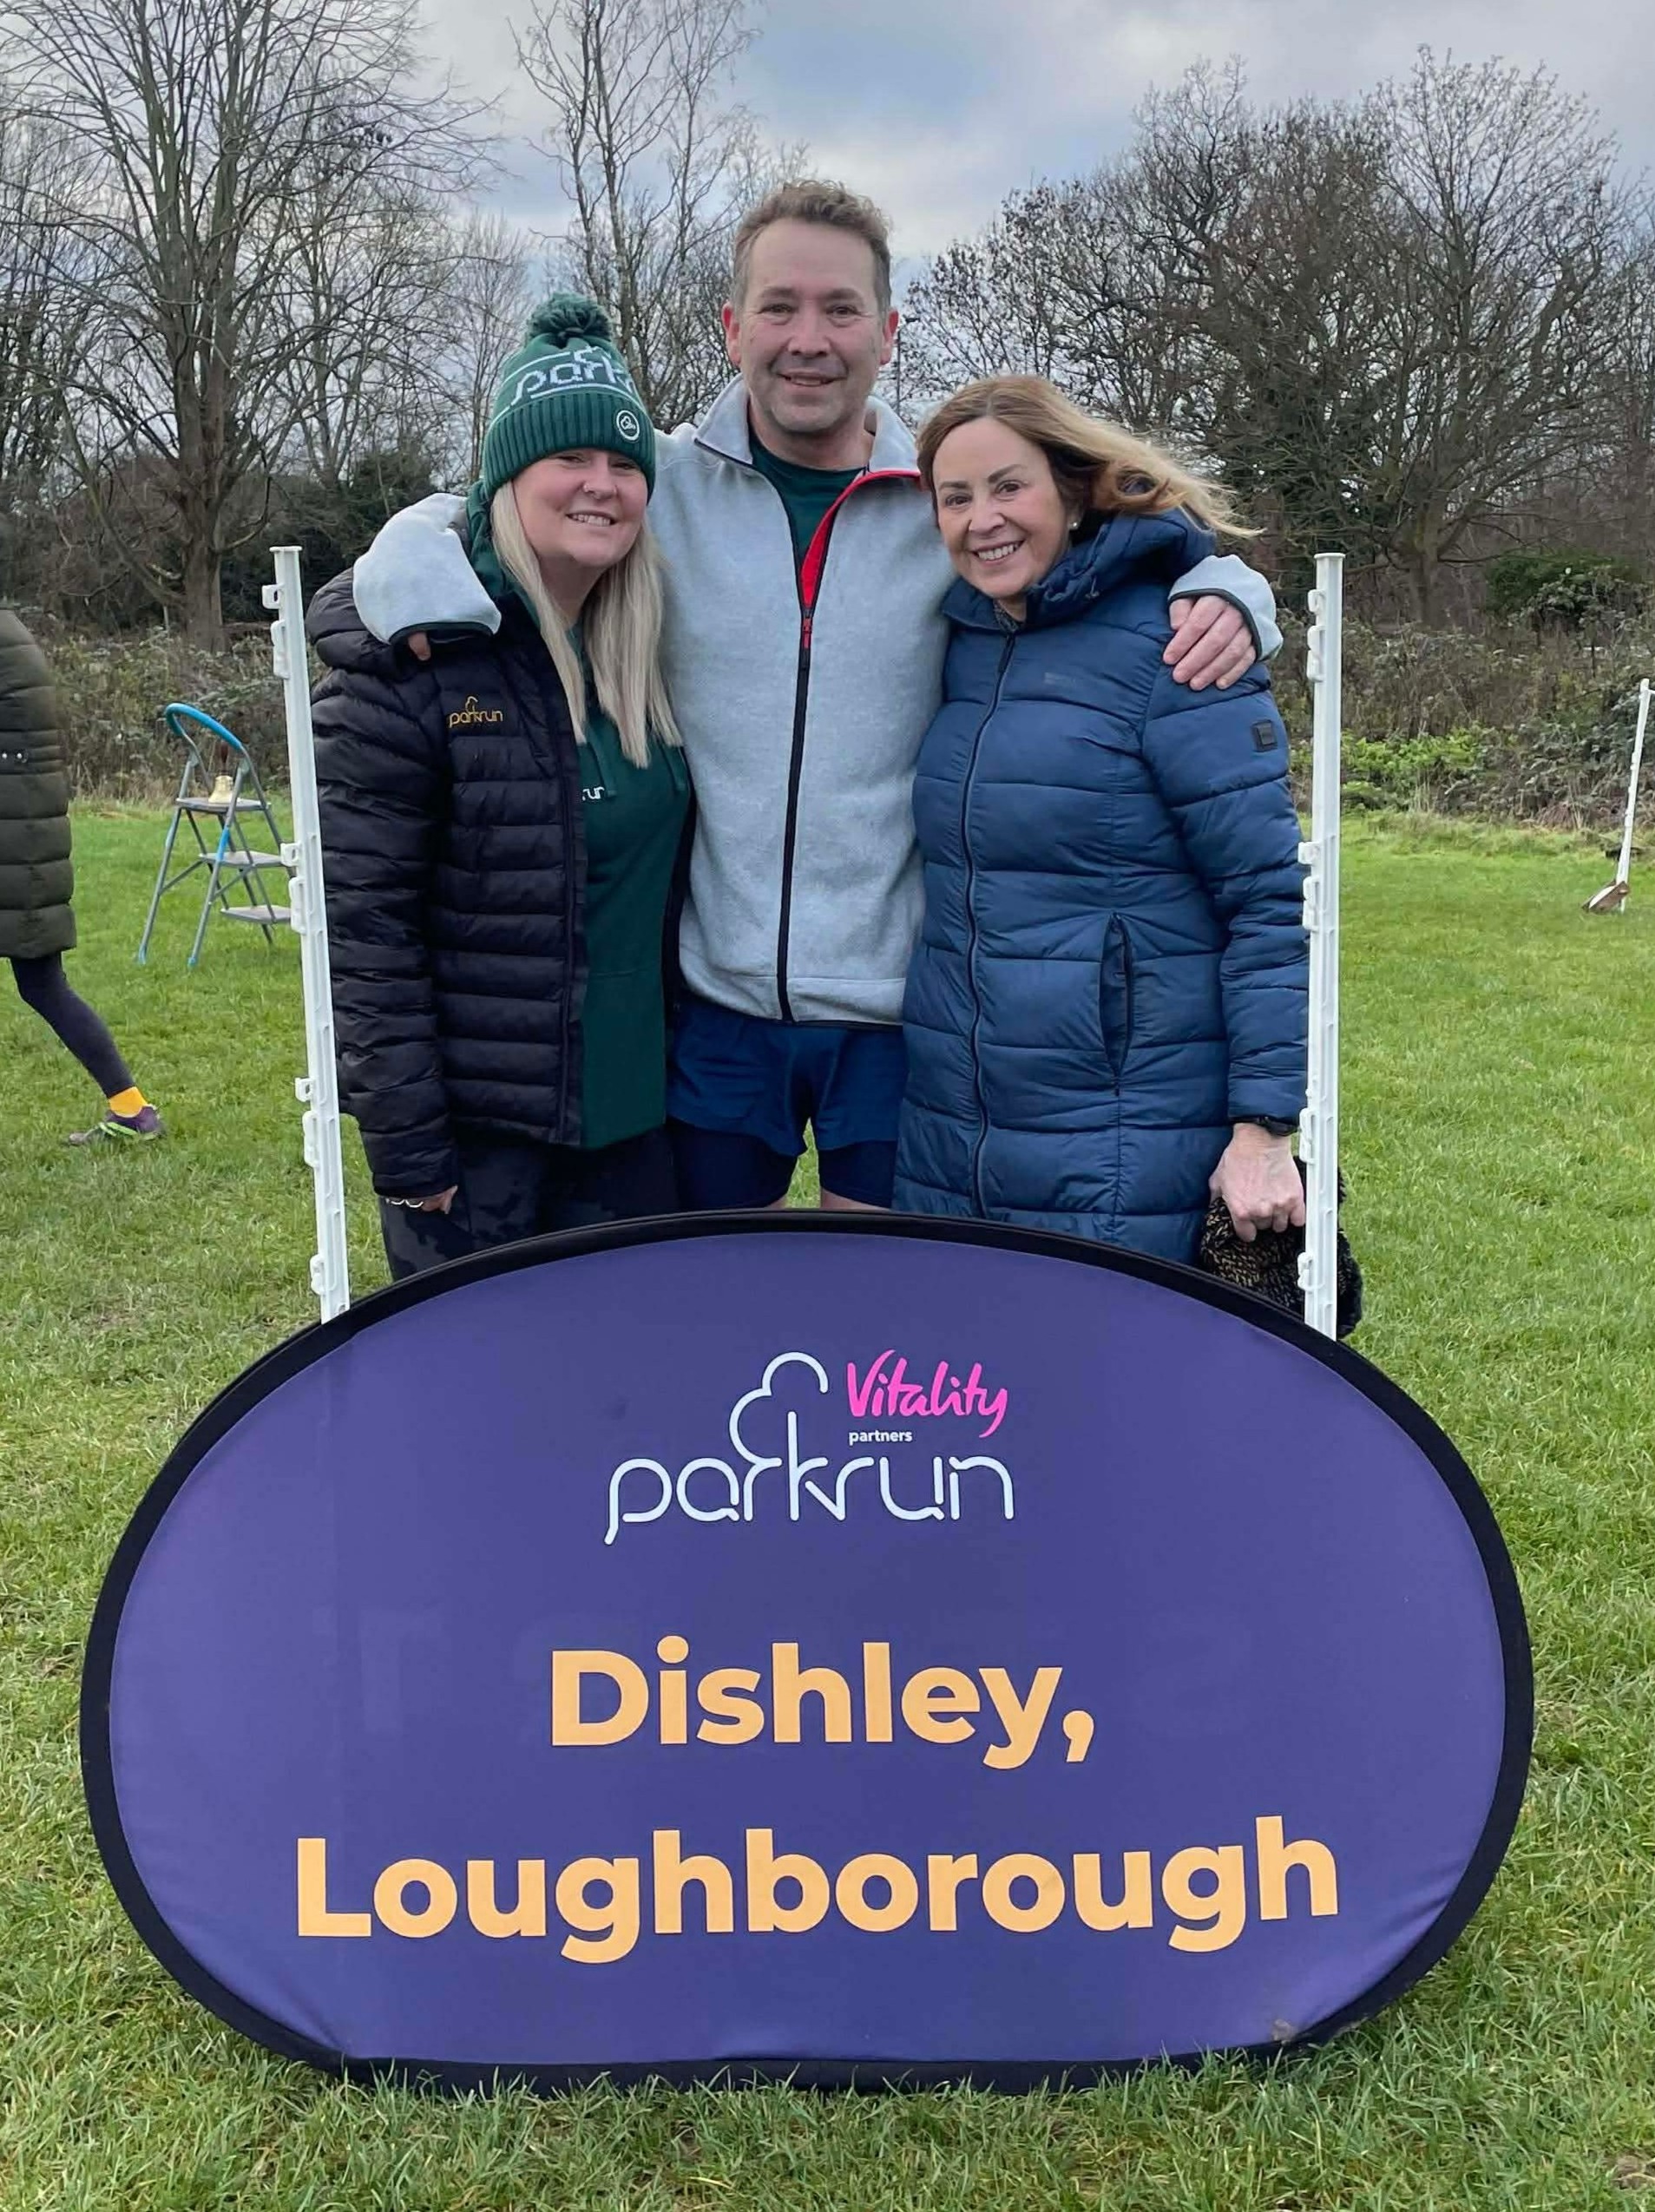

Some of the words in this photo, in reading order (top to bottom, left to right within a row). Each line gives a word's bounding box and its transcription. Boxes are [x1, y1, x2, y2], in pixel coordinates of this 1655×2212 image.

[604, 1351, 1015, 1546] parkrun
[847, 1349, 1008, 1439] Vitality
[848, 1430, 914, 1447] partners
[550, 1636, 1094, 1769] Dishley,
[296, 1815, 1338, 1964] Loughborough
